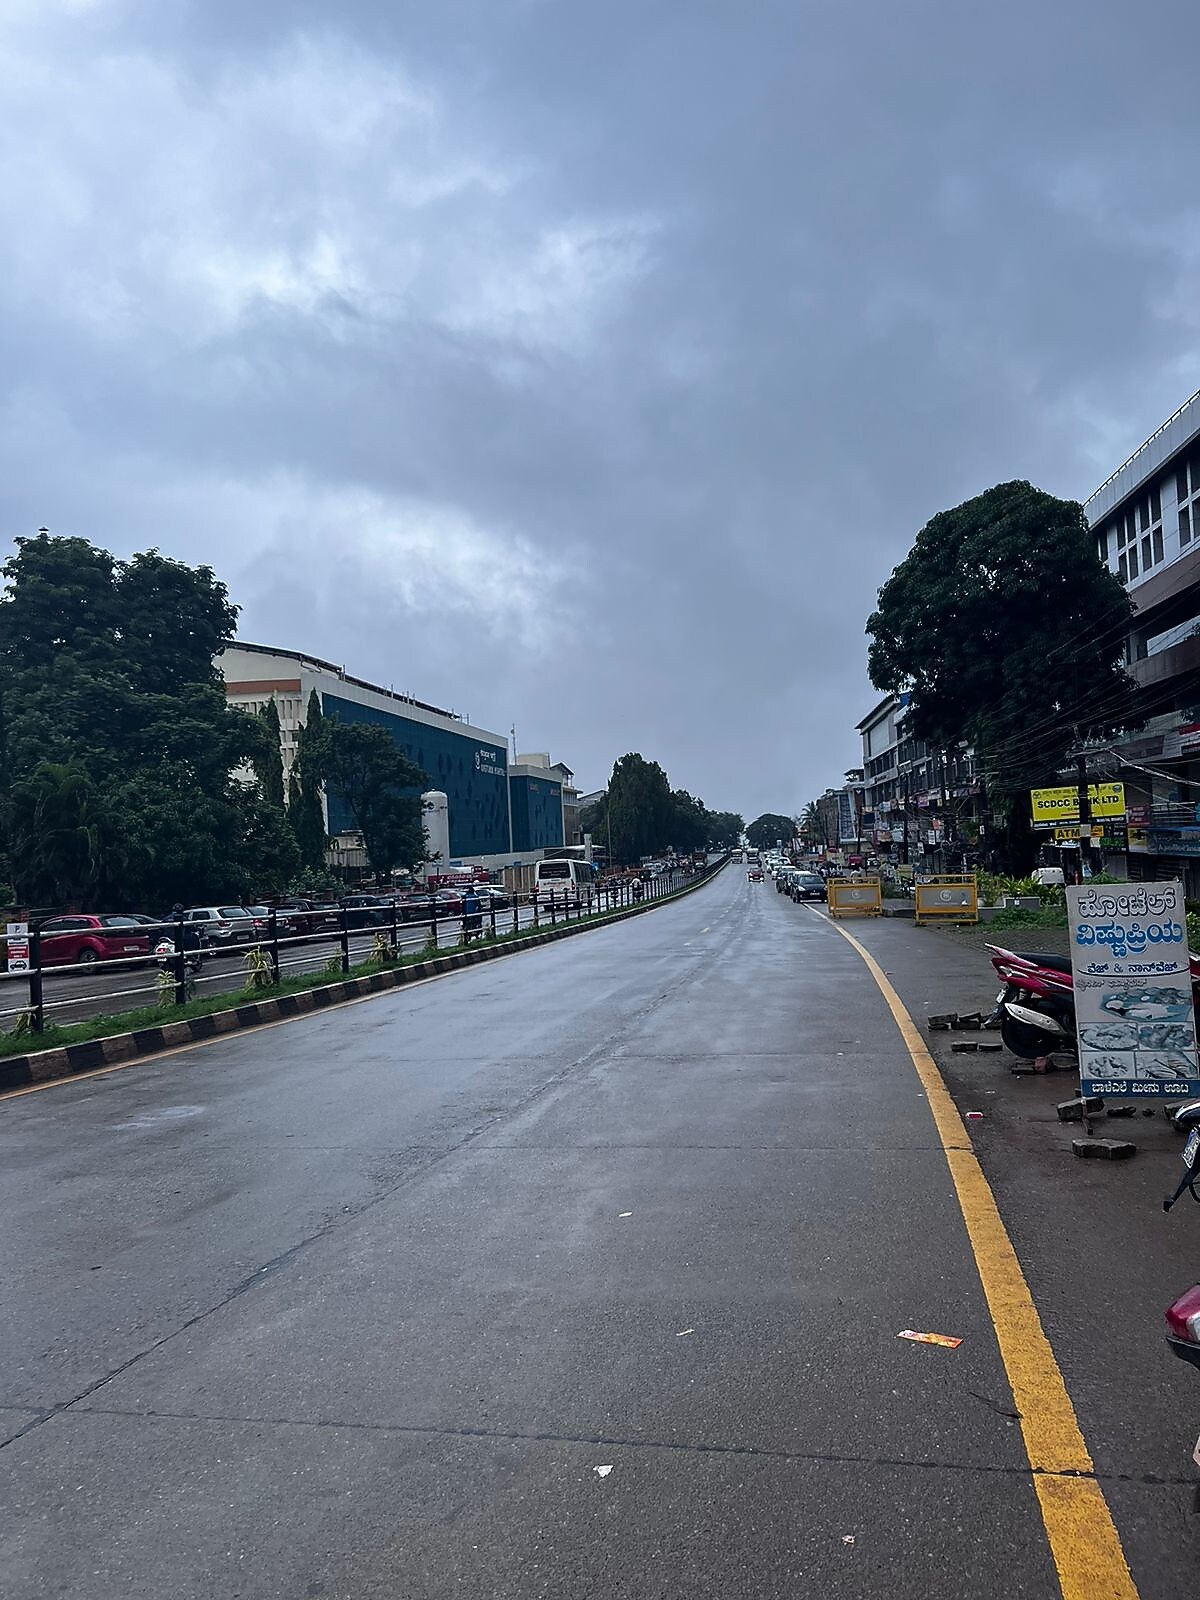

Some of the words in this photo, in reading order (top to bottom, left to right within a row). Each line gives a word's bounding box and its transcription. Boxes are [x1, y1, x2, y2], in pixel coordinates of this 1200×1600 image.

[1037, 799, 1071, 809] SCDCC
[1101, 795, 1119, 804] LTD
[1056, 828, 1080, 839] ATM
[1077, 887, 1176, 918] ಹೋಟೆಲ್
[1114, 963, 1123, 973] &
